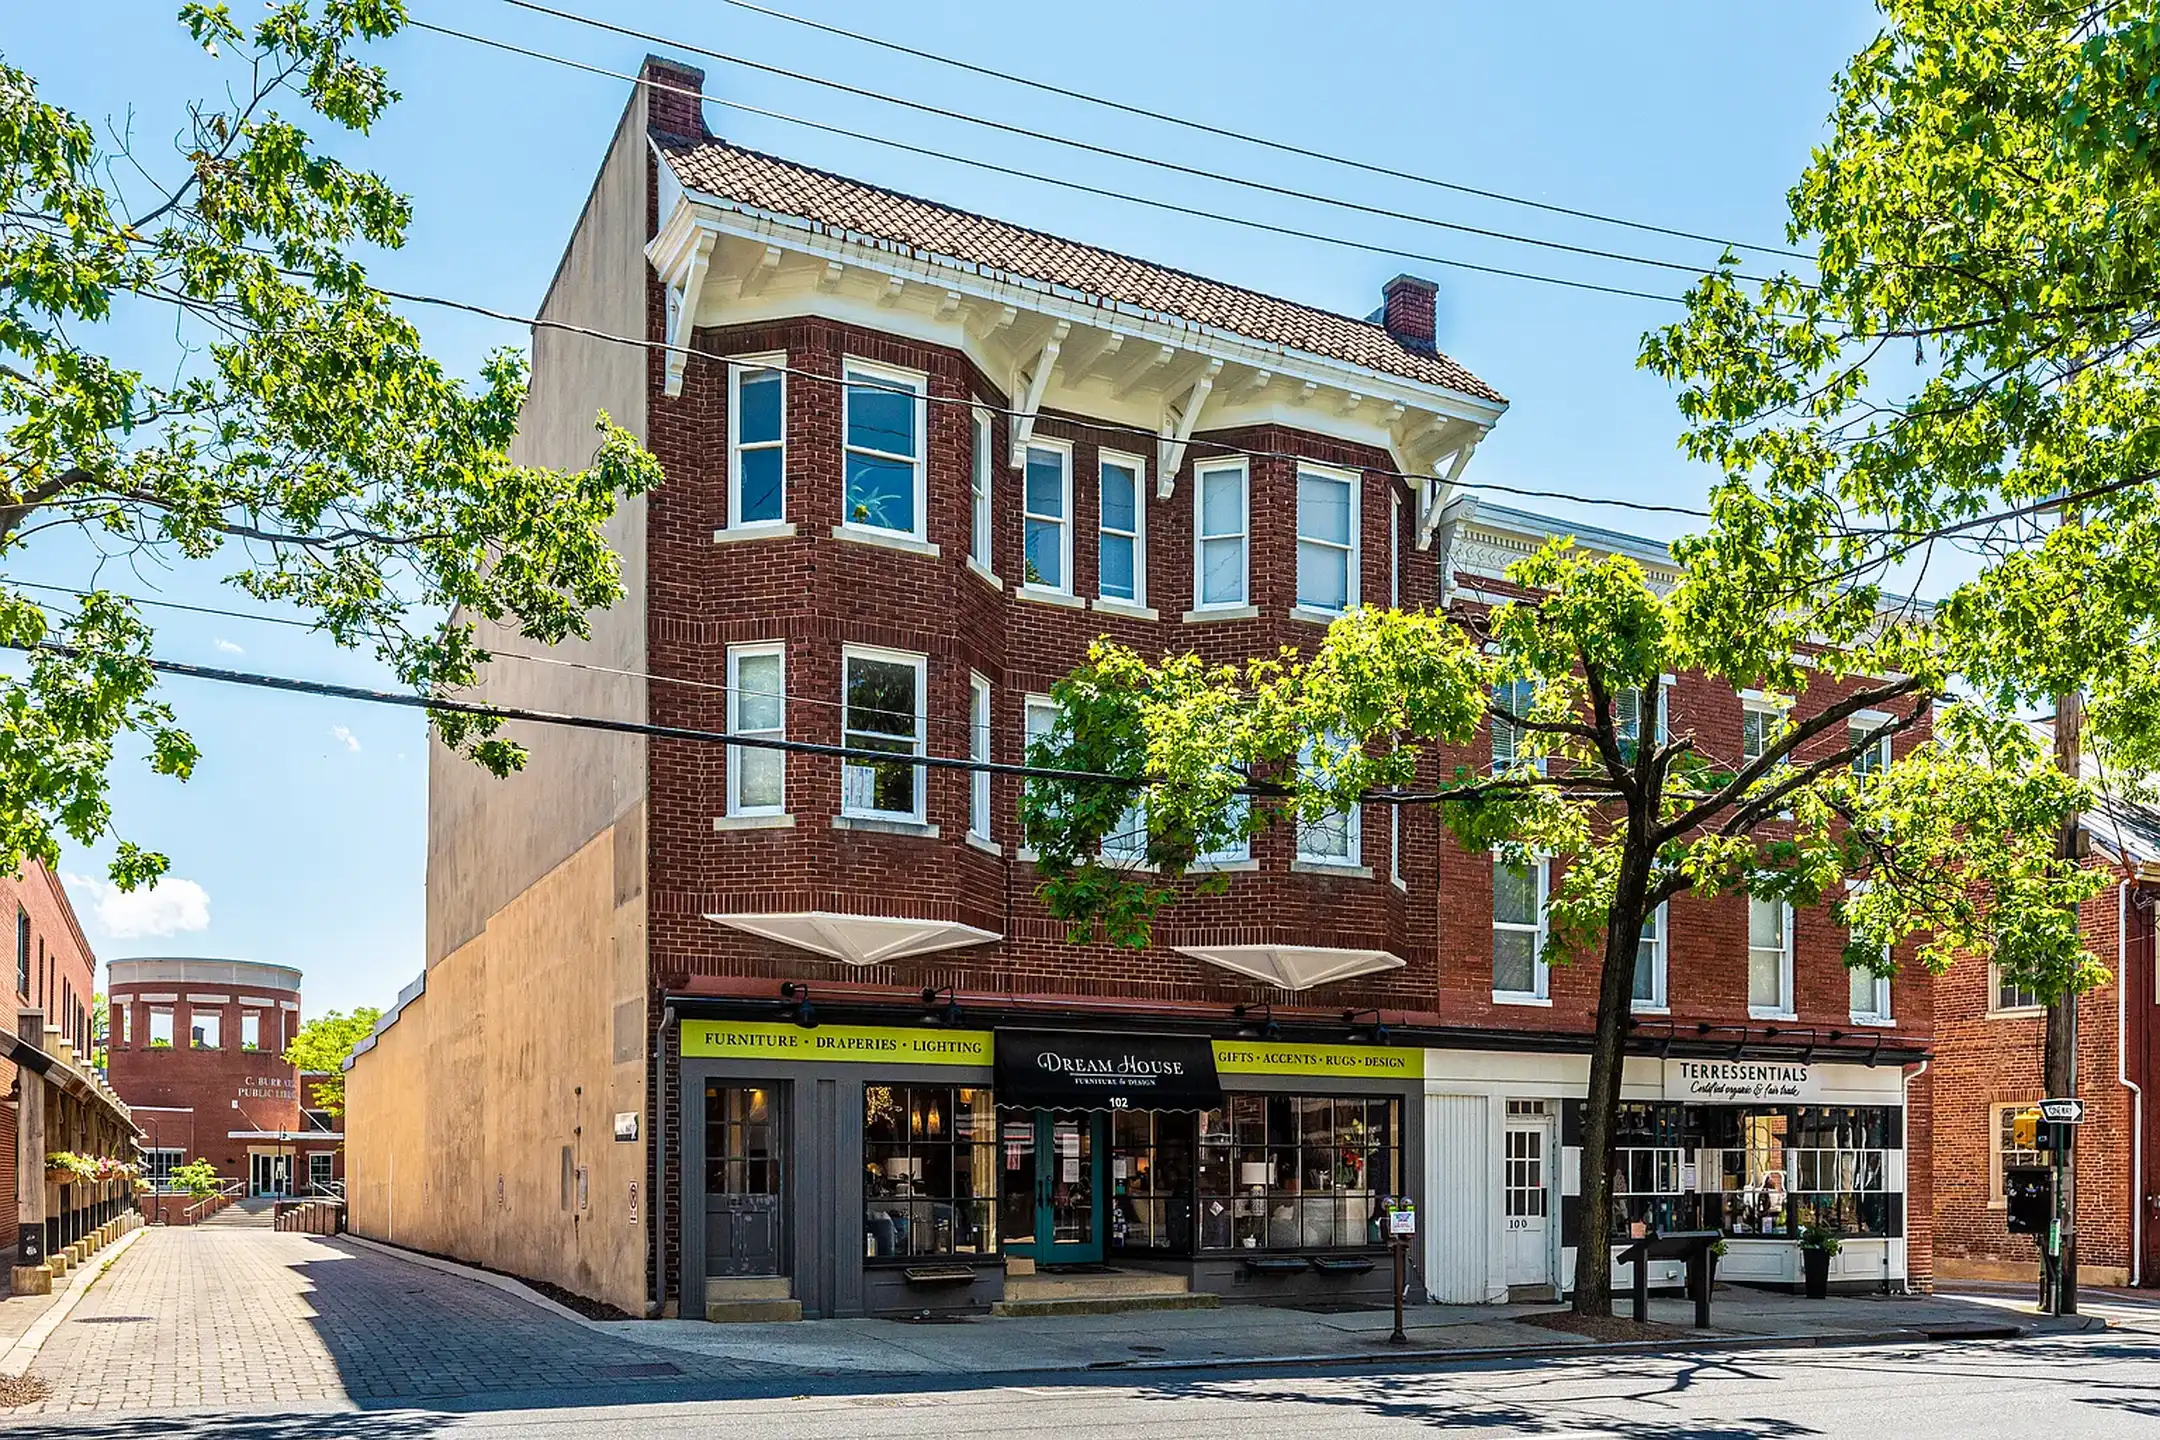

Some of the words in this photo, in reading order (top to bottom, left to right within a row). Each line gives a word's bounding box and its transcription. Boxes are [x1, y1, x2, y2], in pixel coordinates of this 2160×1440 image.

[704, 1032, 798, 1047] FURNITURE
[816, 1037, 897, 1051] DRAPERIES
[913, 1040, 982, 1054] LIGHTING
[1037, 1052, 1113, 1072] DREAM
[1117, 1055, 1184, 1075] HOUSE
[1218, 1052, 1254, 1063] GIFTS
[1263, 1053, 1317, 1065] ACCENTS
[1326, 1055, 1357, 1067] RUGS
[1364, 1057, 1405, 1068] DESIGN
[1680, 1062, 1808, 1082] TERRESSENTIALS
[1690, 1080, 1726, 1097] Certified
[1725, 1085, 1752, 1100] organic
[1753, 1083, 1763, 1098] &
[1764, 1083, 1779, 1098] fair
[1780, 1084, 1801, 1097] trade
[1109, 1097, 1128, 1108] 102
[1510, 1219, 1527, 1229] 100
